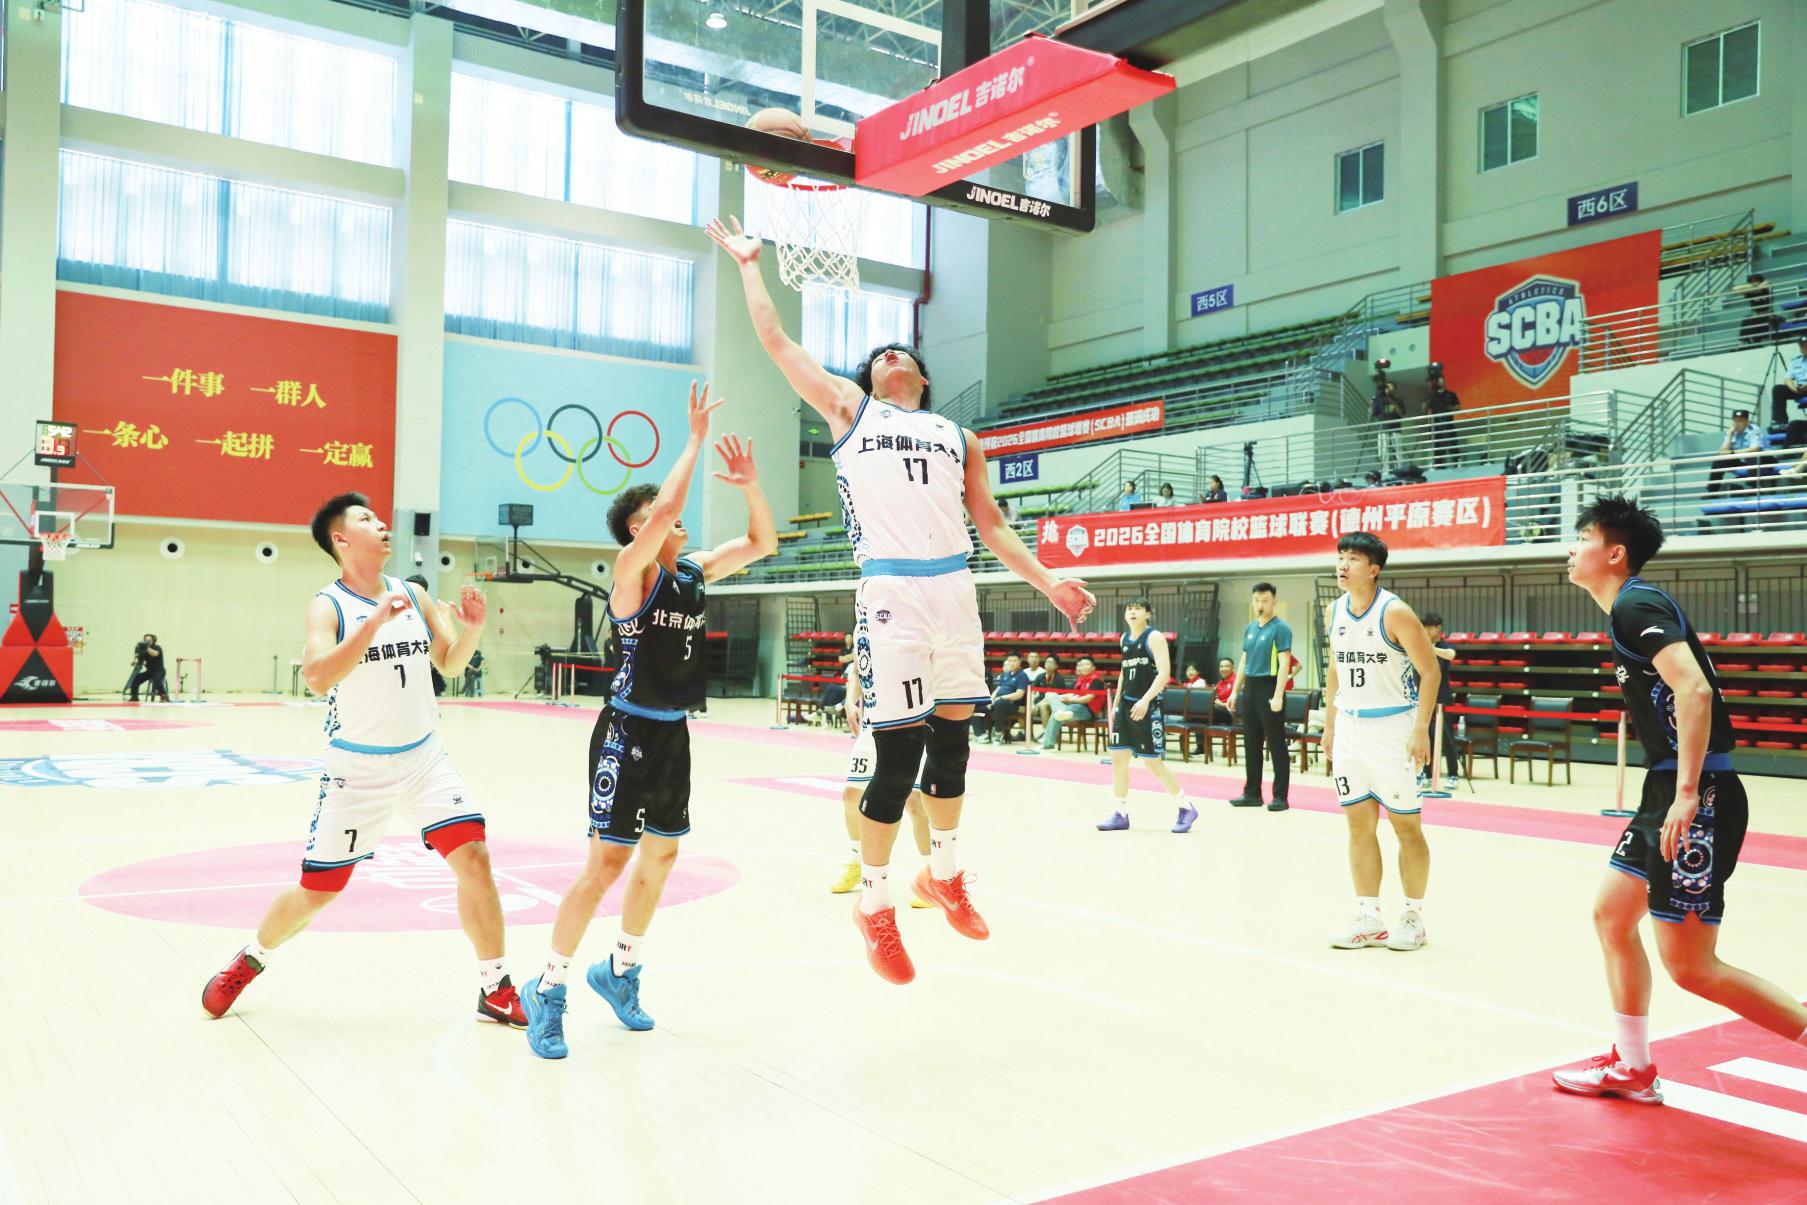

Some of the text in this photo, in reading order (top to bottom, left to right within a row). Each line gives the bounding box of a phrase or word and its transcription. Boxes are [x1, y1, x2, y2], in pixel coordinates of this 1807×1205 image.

[900, 66, 1025, 141] JINOEL 吉诺尔
[931, 139, 1013, 174] JINOEL
[966, 185, 1052, 217] JINOEL 吉诺尔
[1576, 188, 1628, 220] 西6区
[1196, 289, 1228, 312] 西5区
[1486, 299, 1584, 356] SCBA
[142, 368, 327, 408] 一件事 一群人
[82, 420, 169, 450] 一条心
[195, 430, 275, 460] 一起拼
[299, 441, 374, 468] 一定赢
[903, 458, 928, 484] 17
[1004, 459, 1034, 480] 西2区
[683, 635, 693, 660] 5
[394, 664, 406, 688] 7
[1350, 668, 1366, 687] 13
[902, 677, 924, 709] 17
[851, 758, 868, 773] 35
[1335, 776, 1351, 796] 13
[634, 808, 646, 833] 5
[345, 829, 357, 853] 7
